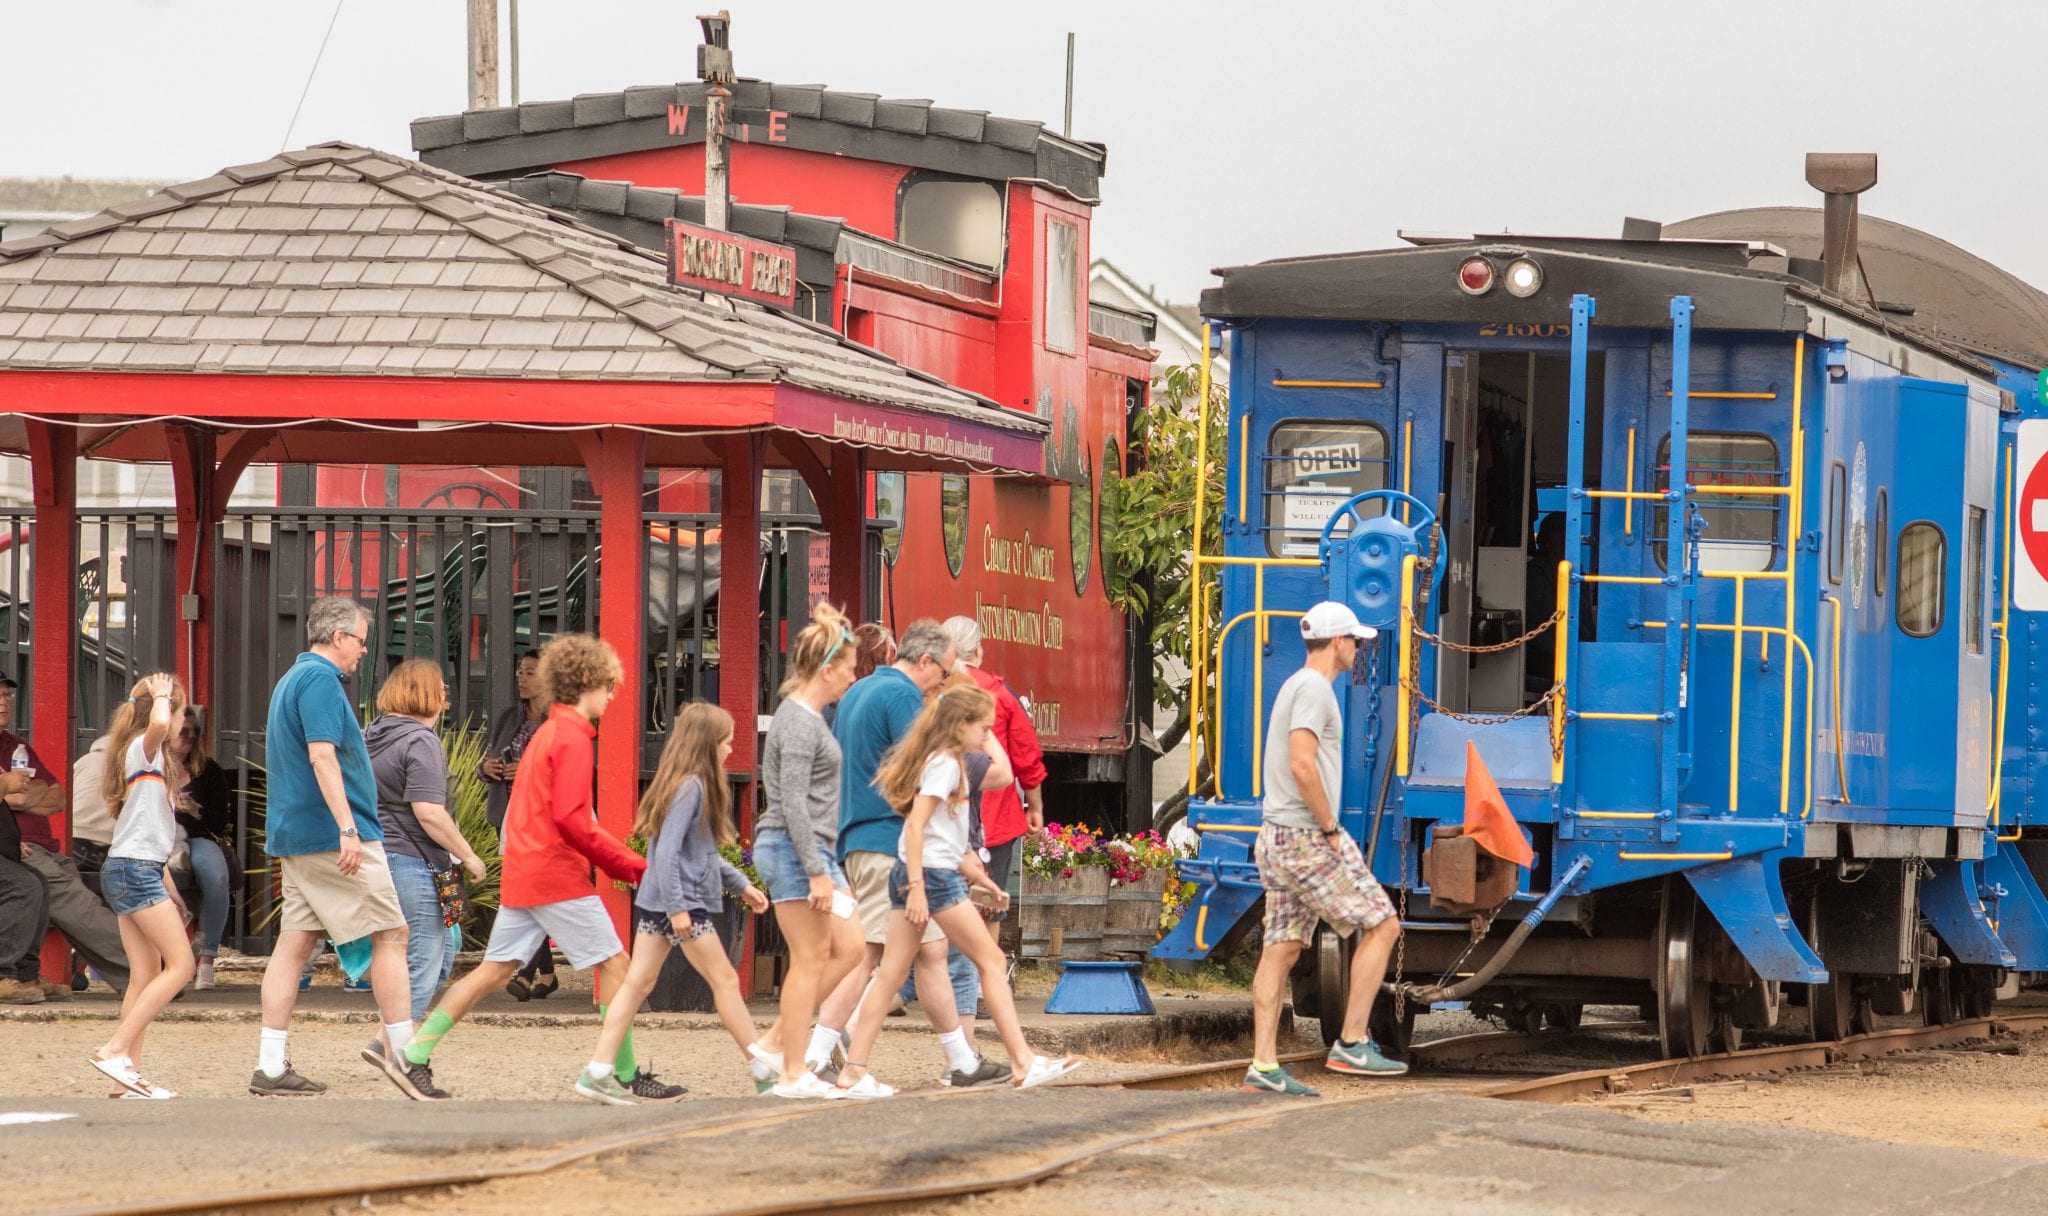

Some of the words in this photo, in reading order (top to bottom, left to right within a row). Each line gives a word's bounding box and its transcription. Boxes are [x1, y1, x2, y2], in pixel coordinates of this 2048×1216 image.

[667, 104, 689, 136] W
[768, 111, 788, 142] E
[1299, 447, 1357, 472] OPEN
[1013, 541, 1023, 575] OF
